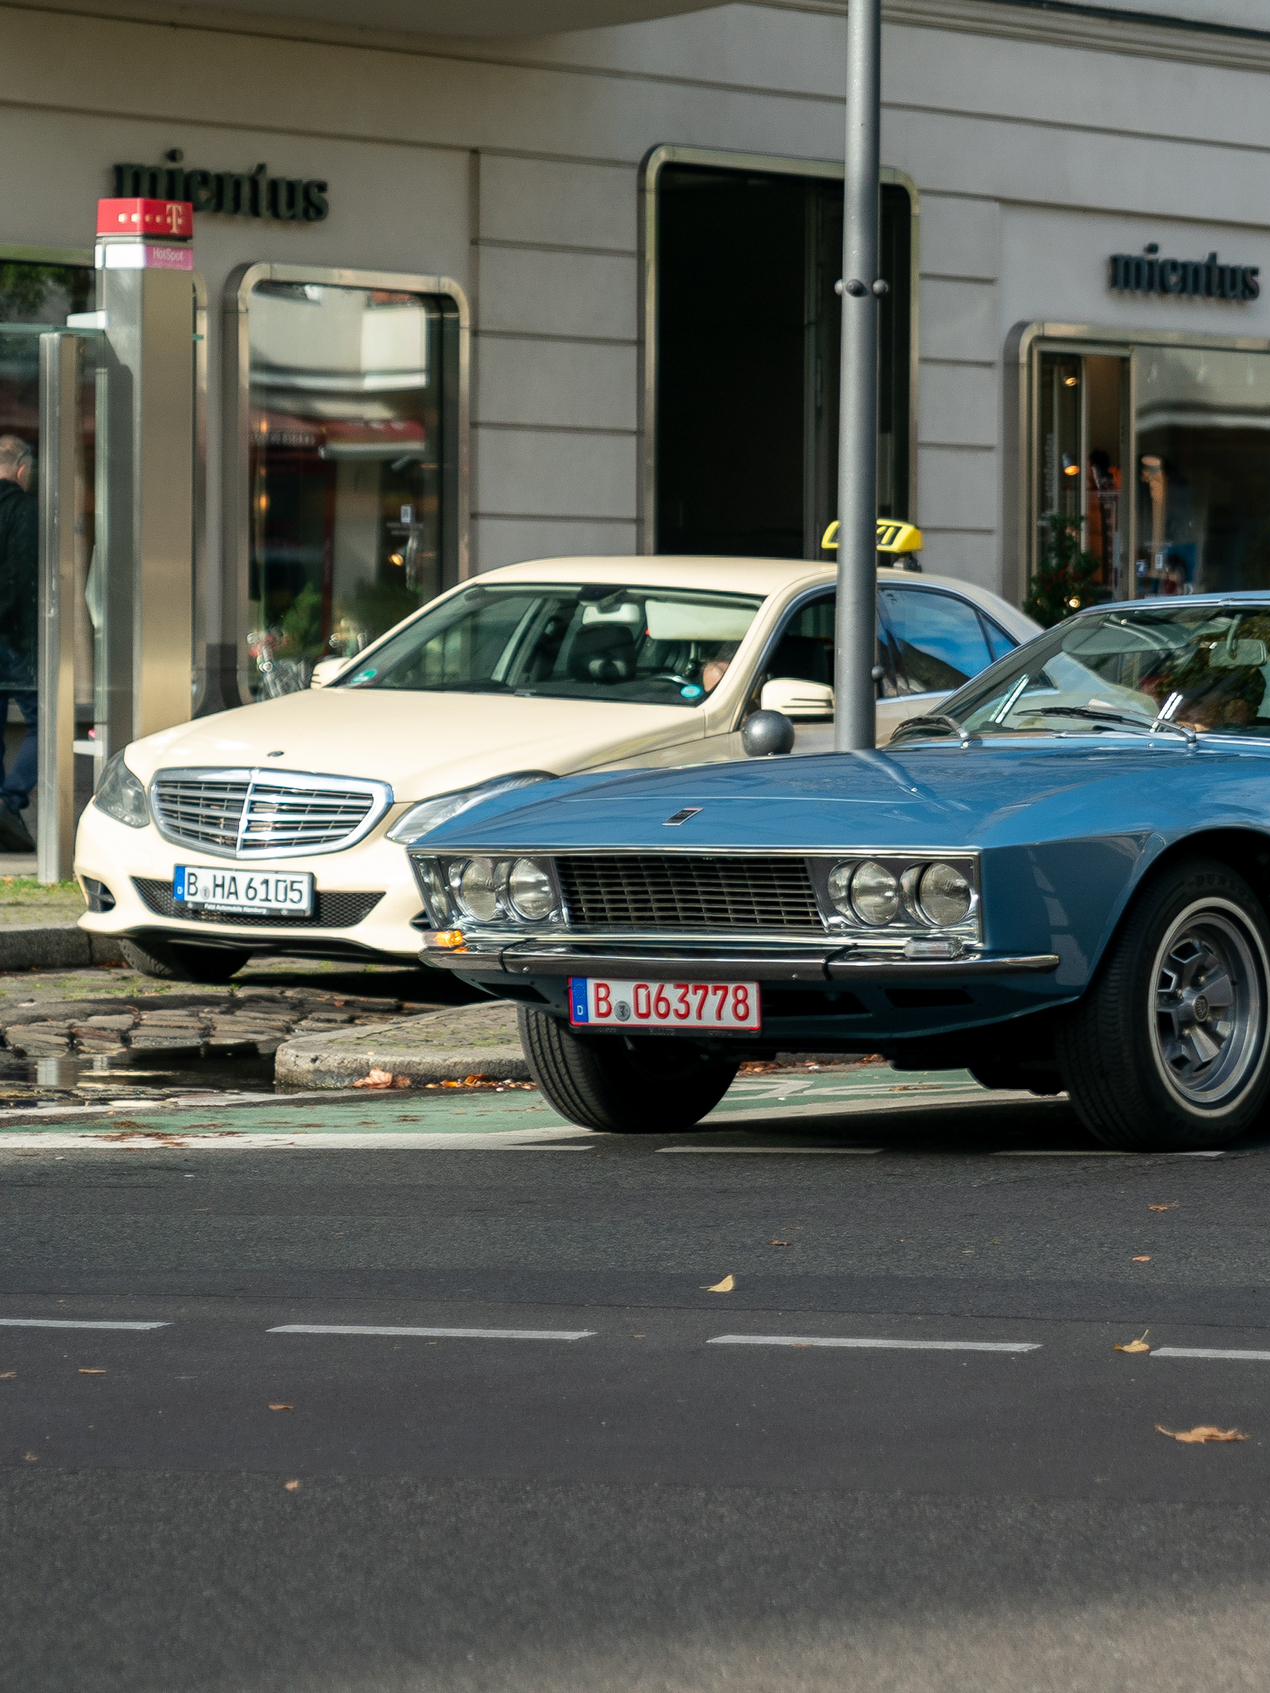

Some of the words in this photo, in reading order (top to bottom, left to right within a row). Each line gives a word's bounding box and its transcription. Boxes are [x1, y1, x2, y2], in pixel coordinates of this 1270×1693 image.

[113, 148, 330, 222] mientus
[152, 247, 184, 262] HotSpot
[1108, 241, 1260, 301] mientus
[187, 872, 199, 897] B
[212, 874, 239, 901] HA
[245, 877, 304, 904] 6105
[593, 982, 612, 1018] B
[632, 982, 750, 1022] 063778
